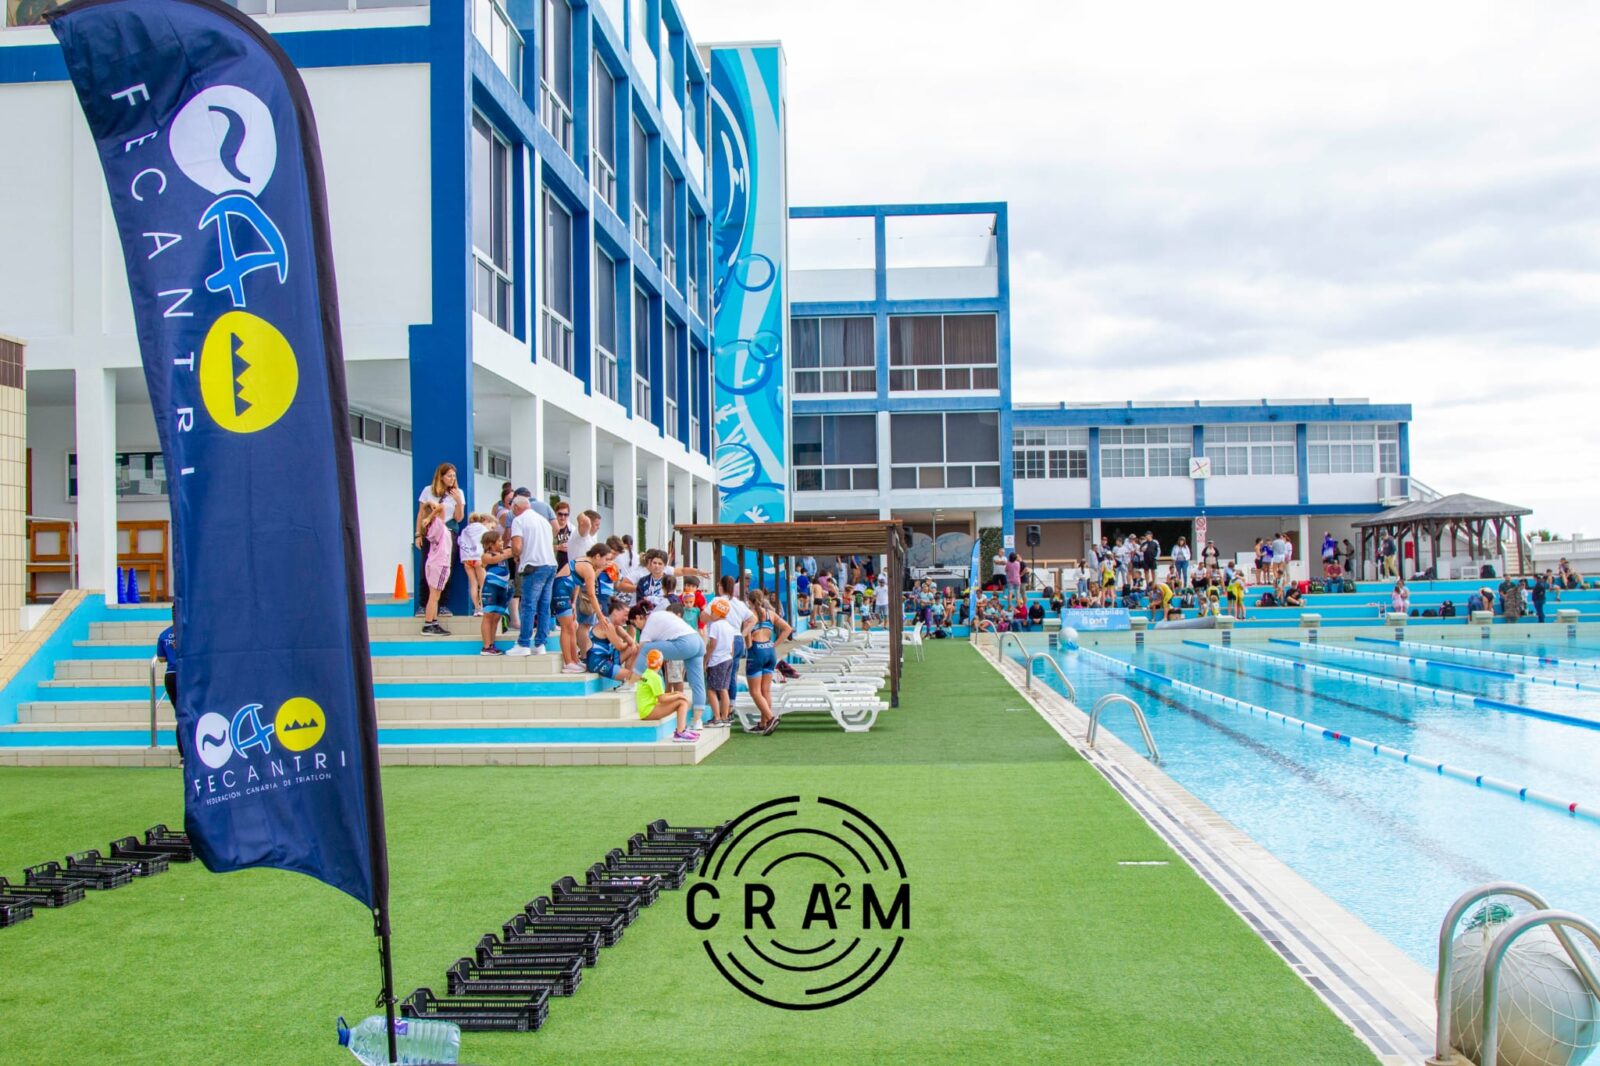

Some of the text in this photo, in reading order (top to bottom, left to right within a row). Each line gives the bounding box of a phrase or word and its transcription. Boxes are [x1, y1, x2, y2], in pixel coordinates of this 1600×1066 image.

[111, 83, 195, 475] FECANTRI
[194, 750, 346, 797] FECANTRI
[246, 782, 278, 795] CANARIA
[283, 779, 292, 787] DE
[295, 773, 331, 783] TRIATLON
